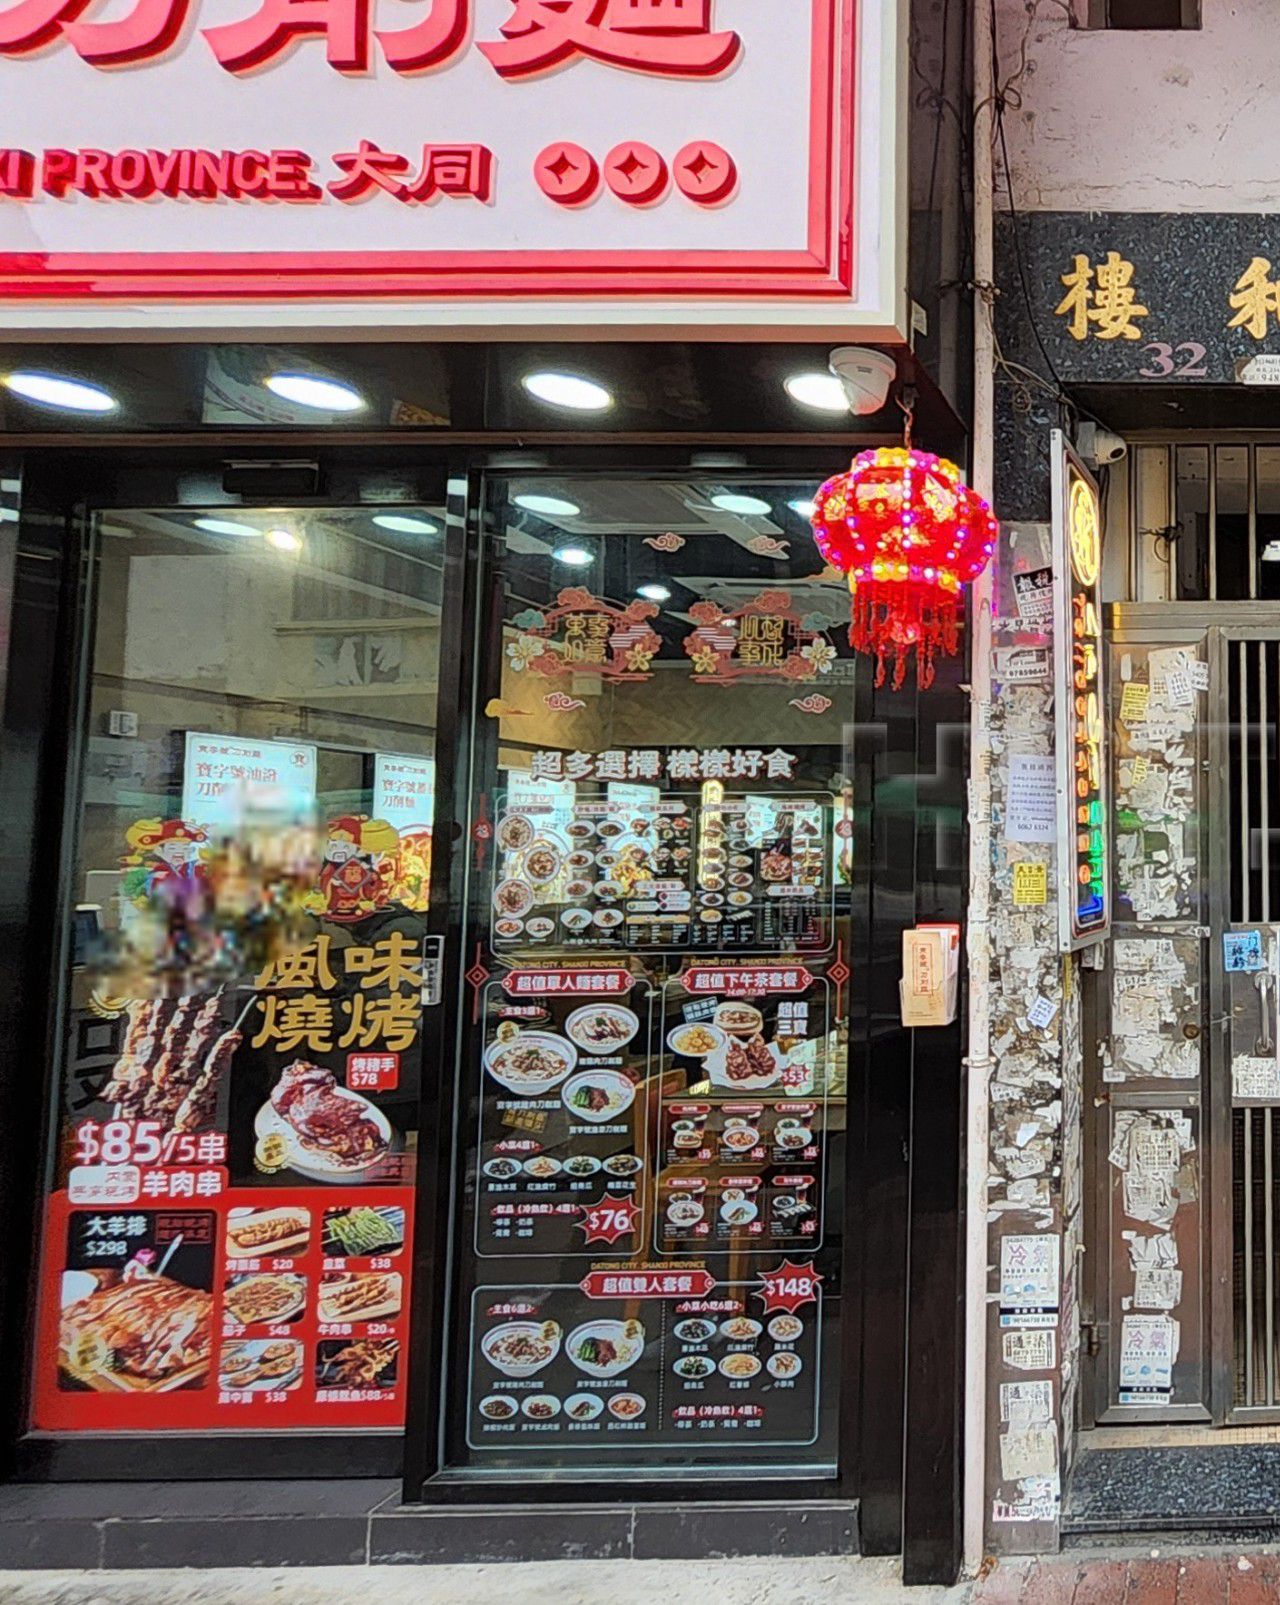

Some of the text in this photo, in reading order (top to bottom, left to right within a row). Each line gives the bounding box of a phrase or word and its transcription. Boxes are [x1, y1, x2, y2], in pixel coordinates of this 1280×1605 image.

[328, 140, 492, 203] 大同
[1139, 342, 1207, 377] 32
[531, 750, 661, 781] 超多選擇
[256, 932, 424, 991] 風味
[694, 972, 798, 988] 超值下午茶套餐
[252, 993, 422, 1052] 燒烤
[351, 1072, 378, 1085] $78
[142, 1170, 222, 1197] 羊肉串
[86, 1215, 148, 1237] 大羊排
[589, 1209, 630, 1231] $76
[86, 1241, 128, 1256] $298
[371, 1258, 391, 1269] $38
[602, 1277, 692, 1293] 超值雙人套餐
[767, 1278, 812, 1296] $148
